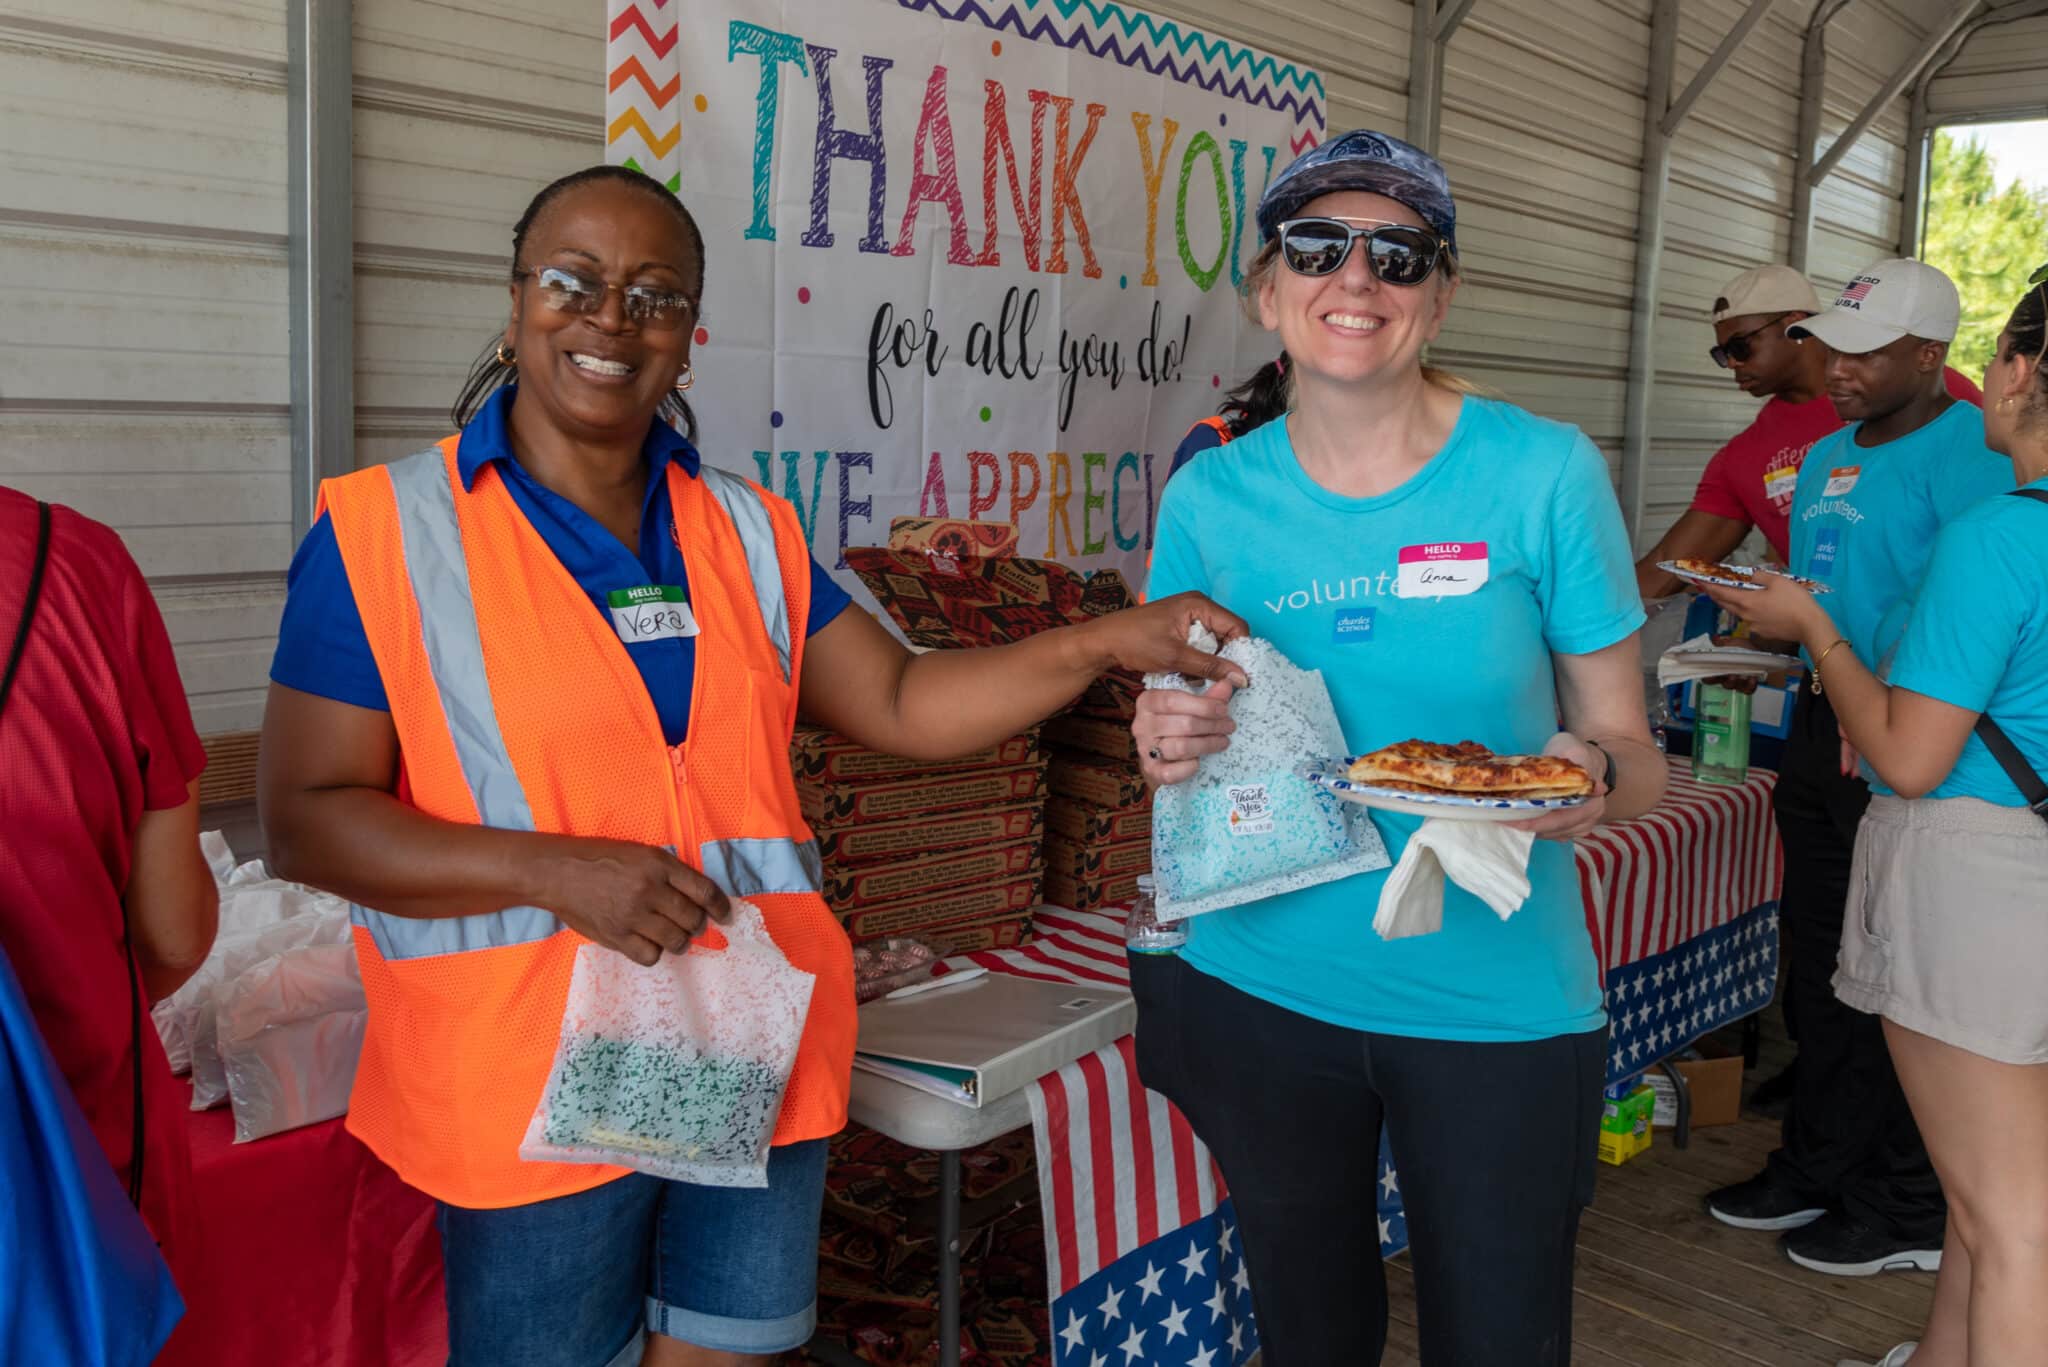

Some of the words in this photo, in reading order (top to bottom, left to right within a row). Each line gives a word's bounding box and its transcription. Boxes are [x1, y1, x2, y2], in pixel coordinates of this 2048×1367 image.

[729, 21, 1106, 278] THANK
[1131, 112, 1277, 294] YOU
[1835, 299, 1860, 311] USA
[868, 302, 948, 429] for
[966, 286, 1043, 380] all
[1058, 329, 1126, 432] you
[1137, 300, 1191, 387] do!
[752, 450, 873, 570] WE
[1802, 498, 1865, 524] volunteer
[1424, 544, 1461, 555] HELLO
[627, 587, 663, 599] HELLO
